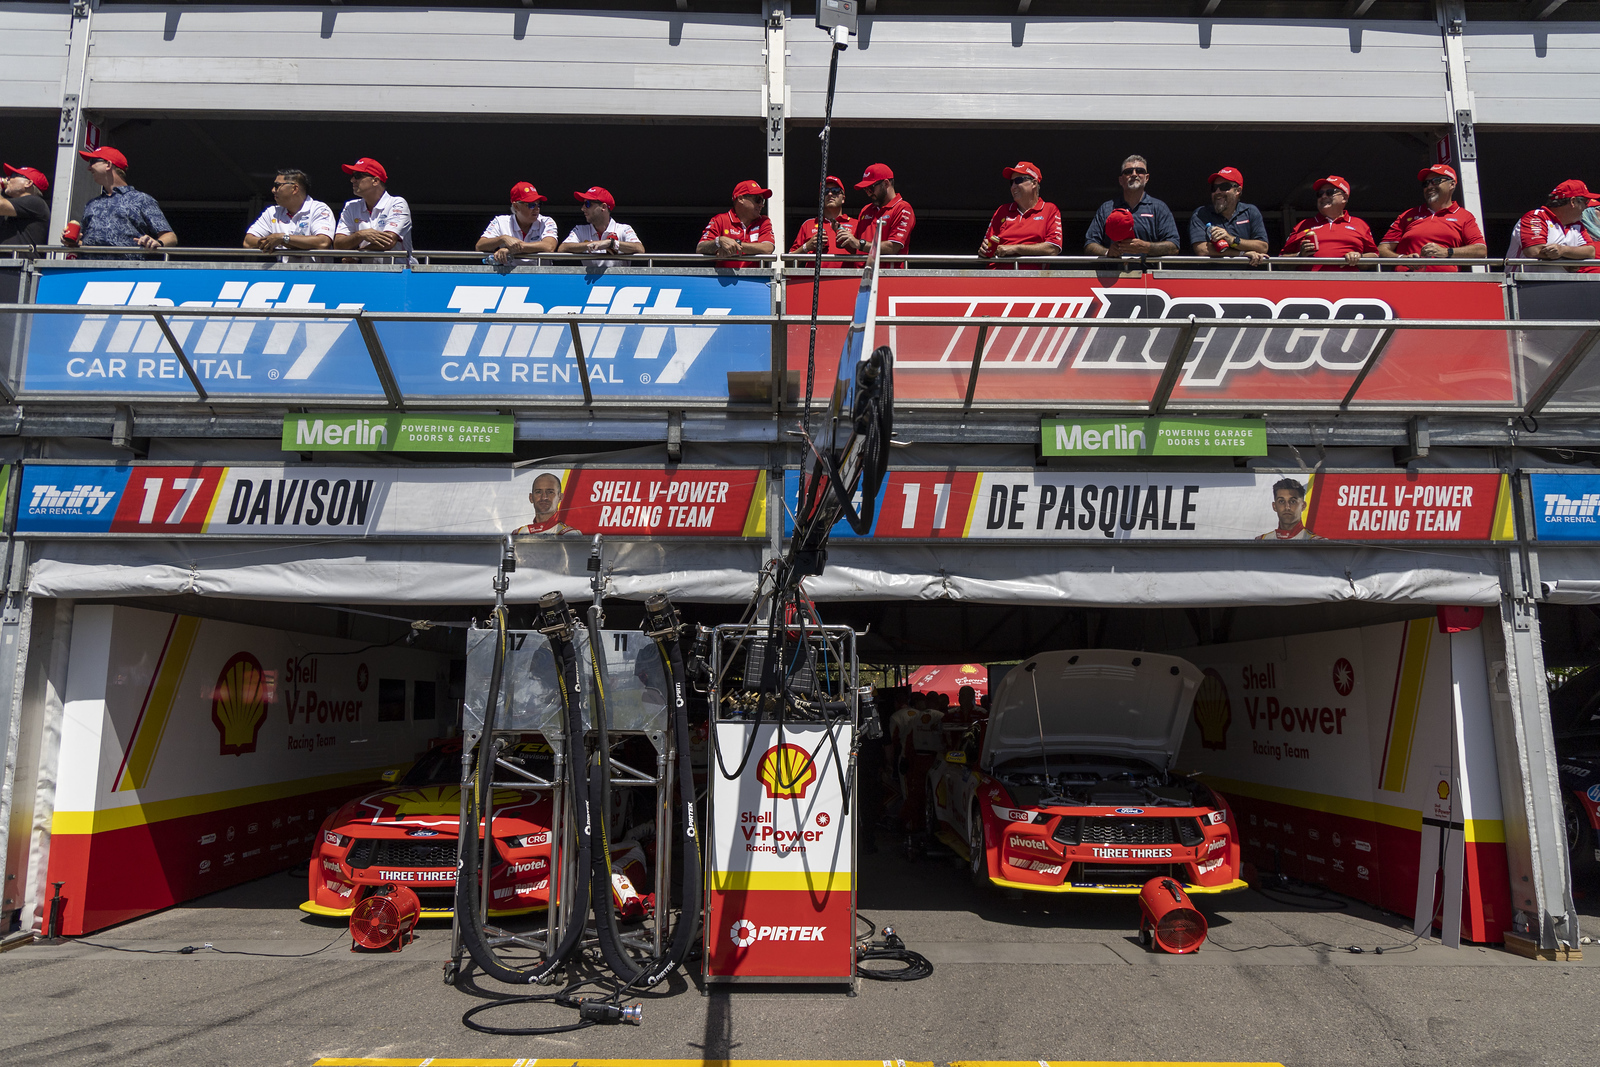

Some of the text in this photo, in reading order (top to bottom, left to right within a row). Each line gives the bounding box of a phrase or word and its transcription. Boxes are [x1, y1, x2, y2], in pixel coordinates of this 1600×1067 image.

[68, 281, 365, 380] Thrifty
[441, 286, 731, 384] Thrifty
[66, 358, 127, 378] CAR
[137, 358, 252, 379] RENTAL
[441, 361, 500, 382] CAR
[511, 362, 624, 384] RENTAL
[296, 419, 388, 445] Merlin
[401, 425, 500, 434] POWERING GARAGE
[409, 434, 444, 442] DOORS
[458, 435, 491, 443] GATES
[1055, 425, 1146, 450] Merlin
[1158, 429, 1253, 437] POWERING GARAGE
[1167, 438, 1201, 446] DOORS
[29, 485, 116, 515] Thrifty
[138, 478, 204, 524] 17
[227, 479, 374, 525] DAVISON
[590, 481, 729, 503] SHELL V-POWER
[1337, 485, 1473, 507] SHELL V-POWER
[28, 507, 47, 515] CAR
[901, 482, 952, 529] 11
[986, 484, 1199, 538] DE PASQUALE
[1544, 494, 1600, 516] Thrif
[598, 506, 716, 528] RACING TEAM
[1347, 509, 1462, 532] RACING TEAM
[508, 633, 528, 651] 17
[613, 633, 628, 651] 11
[285, 657, 318, 683] Shell
[1242, 663, 1276, 689] Shell
[285, 690, 363, 725] V-Power
[1244, 697, 1347, 735] V-Power
[287, 733, 336, 752] Racing Team
[1253, 740, 1310, 760] Racing Team
[741, 811, 772, 823] Shell
[741, 826, 824, 842] V-Power
[746, 844, 807, 855] Racing Team
[1092, 848, 1173, 859] THREE THREES
[379, 870, 415, 881] THREE
[756, 926, 827, 941] PIRTEK
